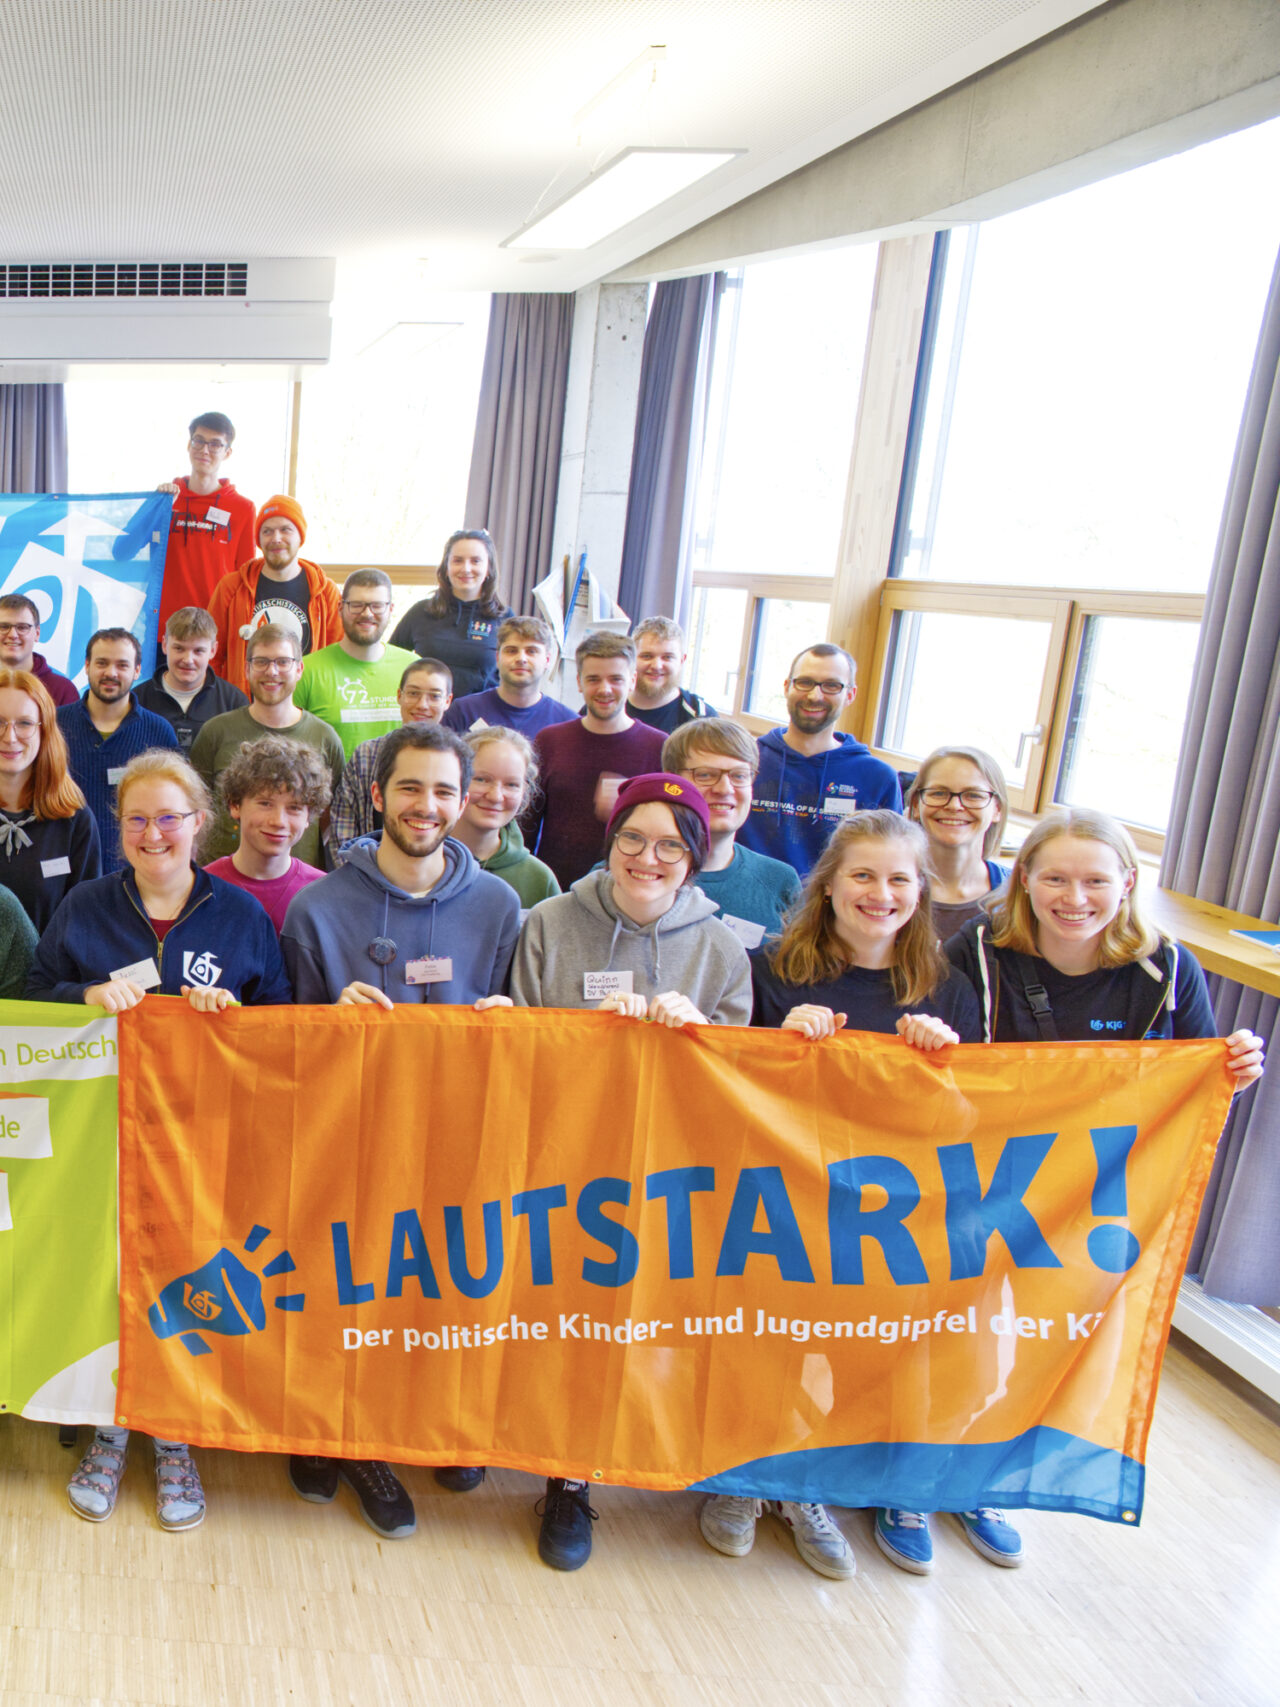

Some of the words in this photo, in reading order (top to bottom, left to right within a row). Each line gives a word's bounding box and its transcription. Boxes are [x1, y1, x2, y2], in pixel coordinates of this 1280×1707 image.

[343, 1326, 393, 1350] Der
[403, 1315, 549, 1353] politische
[559, 1313, 674, 1345] Kinder-
[684, 1307, 744, 1336] und
[754, 1306, 978, 1344] Jugendgipfel
[990, 1306, 1055, 1340] der
